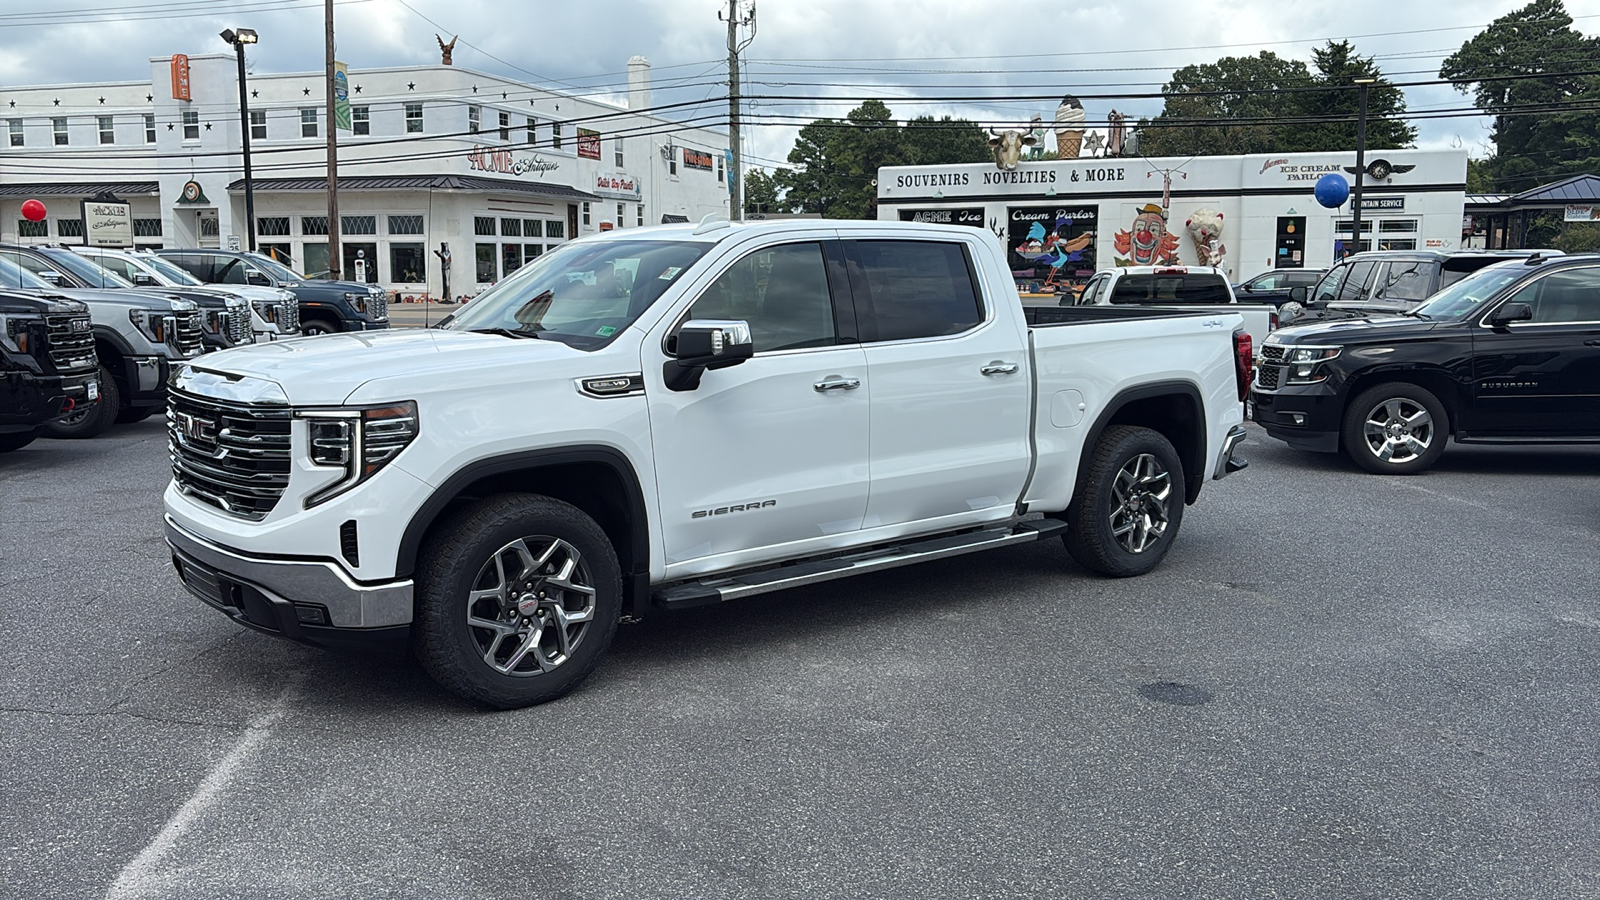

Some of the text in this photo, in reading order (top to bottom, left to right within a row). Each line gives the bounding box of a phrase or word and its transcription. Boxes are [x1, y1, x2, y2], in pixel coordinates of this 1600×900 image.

[179, 56, 188, 98] ACME
[467, 144, 514, 175] ACME
[523, 153, 560, 178] Antiques
[1280, 164, 1341, 173] ICE CREAM
[611, 177, 620, 191] Boy
[897, 168, 1125, 188] SOUVENIRS NOVELTIES & MORE
[1287, 173, 1328, 181] PARLO
[1380, 199, 1403, 208] SERVICE
[912, 210, 982, 222] ACME Ice
[1011, 208, 1096, 221] Cream Parlor
[176, 411, 216, 444] GMC
[691, 499, 777, 519] SIERRA
